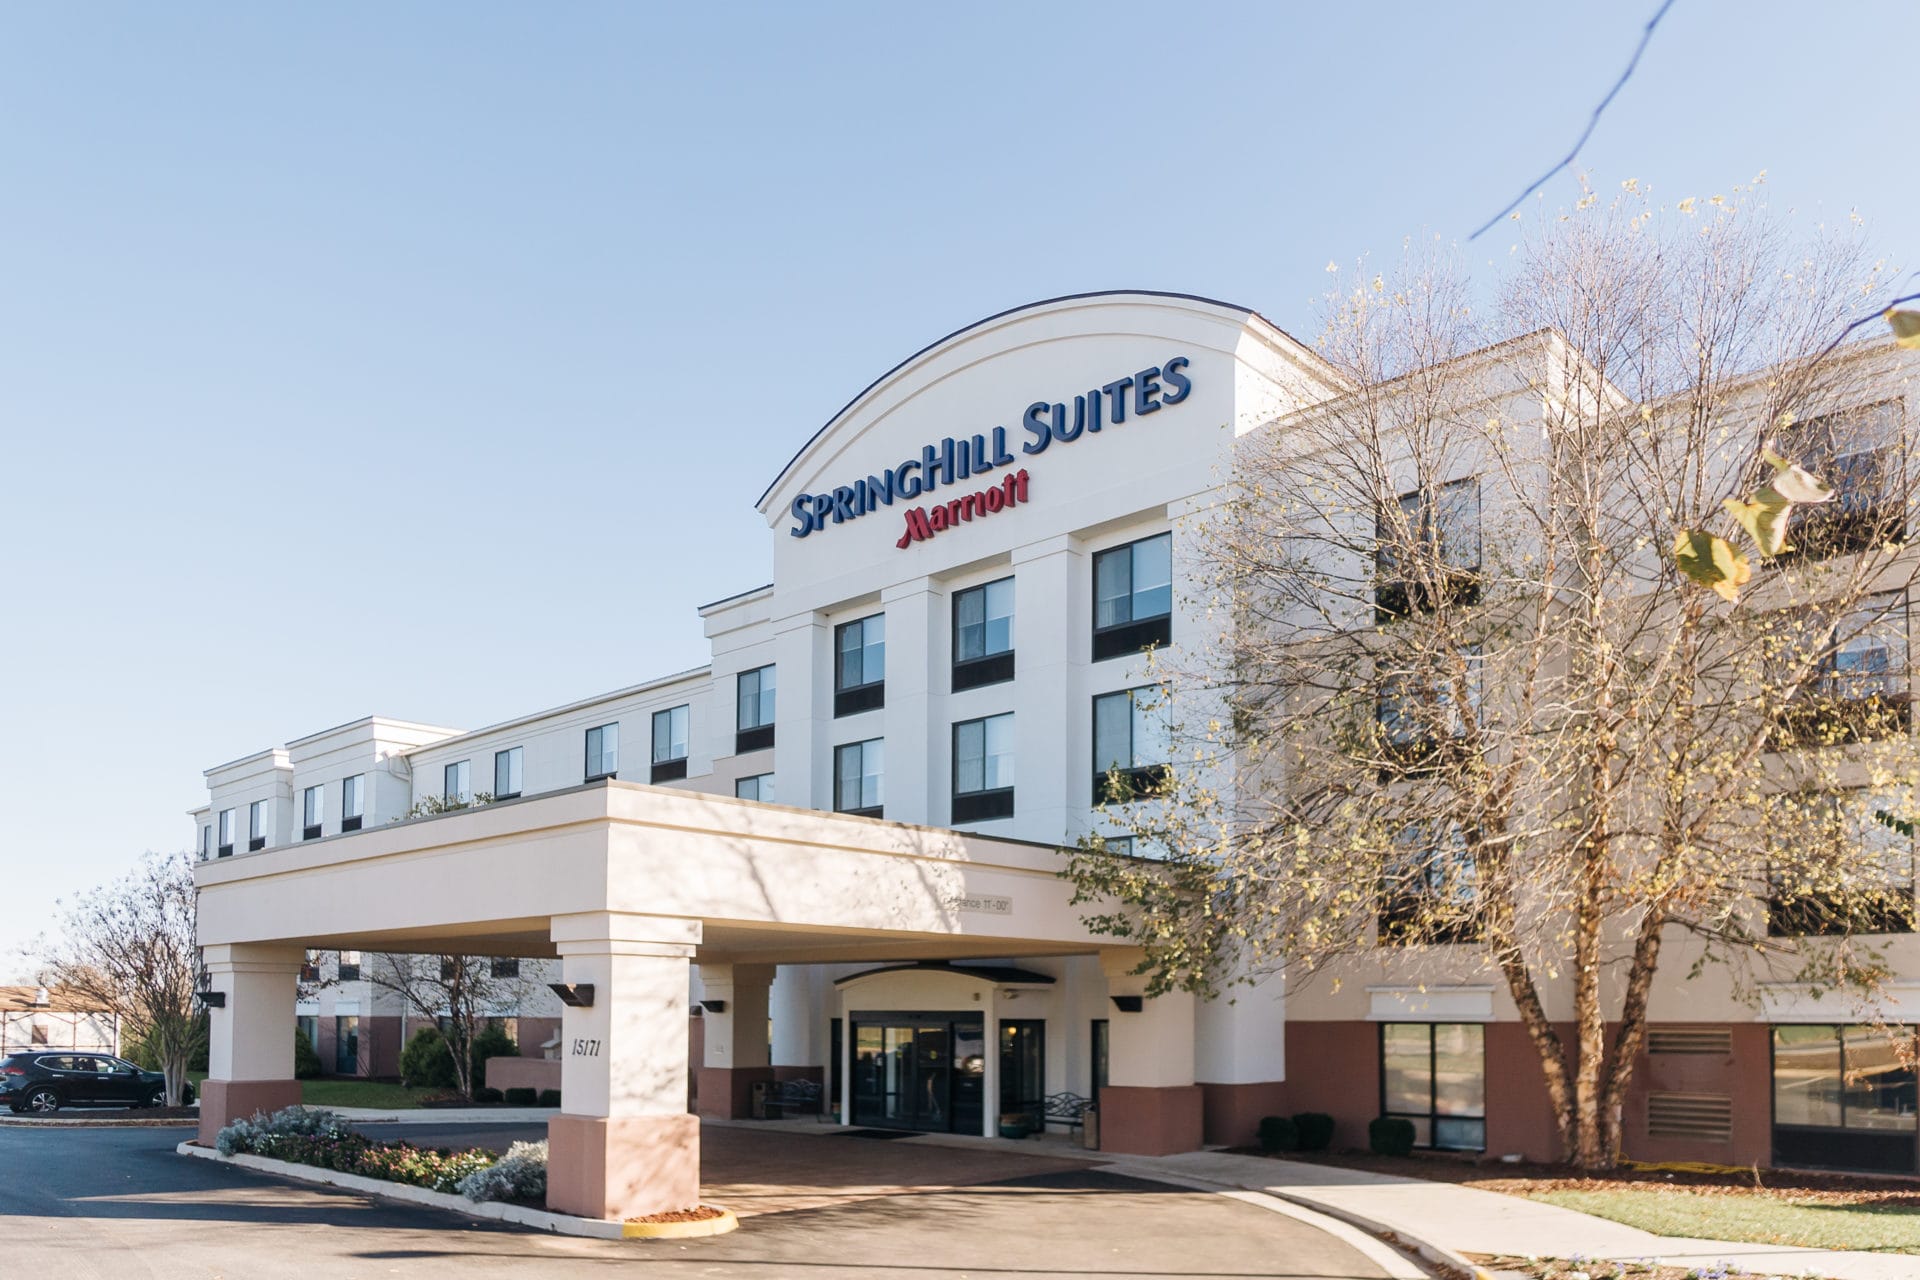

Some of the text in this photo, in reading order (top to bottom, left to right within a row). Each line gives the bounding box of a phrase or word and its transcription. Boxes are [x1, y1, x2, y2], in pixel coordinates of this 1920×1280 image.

[791, 356, 1192, 538] SPRINGHILL SUITES
[896, 468, 1030, 549] Marriott
[572, 1038, 601, 1056] 15171
